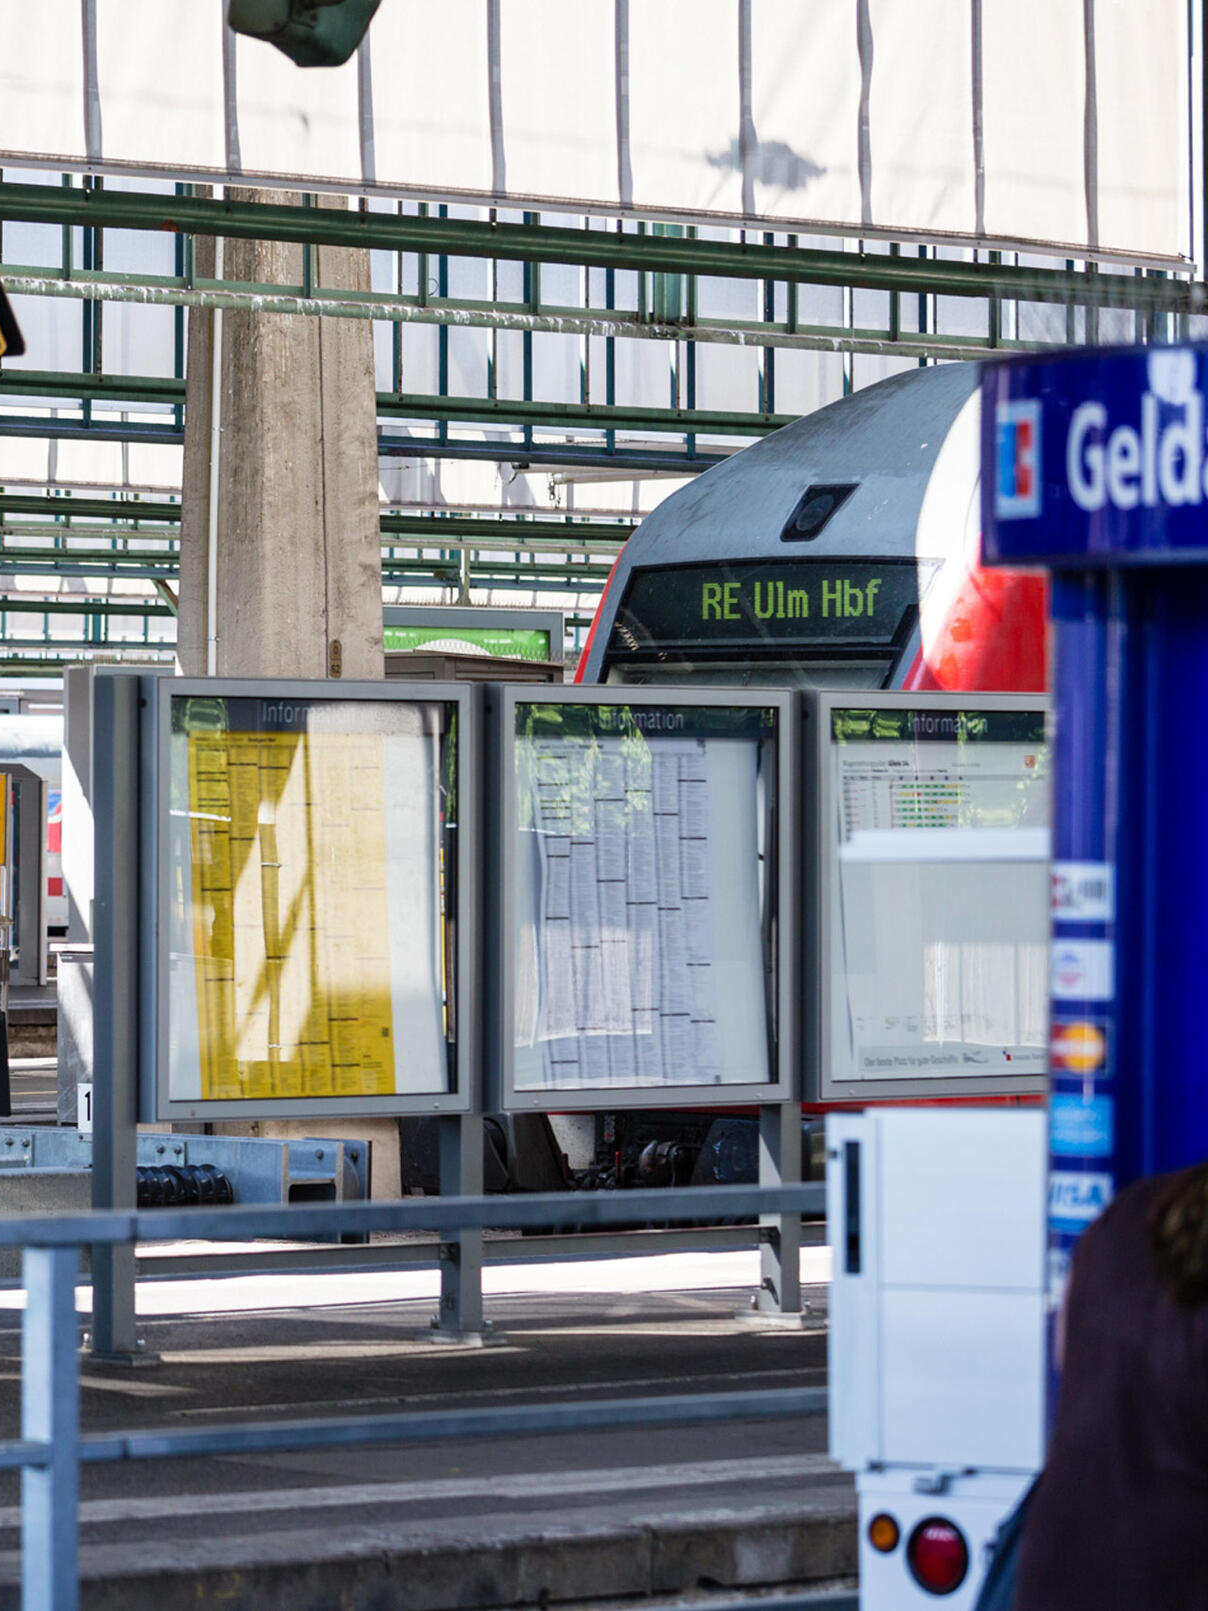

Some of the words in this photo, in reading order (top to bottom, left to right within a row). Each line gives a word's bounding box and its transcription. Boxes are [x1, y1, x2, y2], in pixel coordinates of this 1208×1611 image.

[1066, 391, 1208, 512] Geld
[702, 582, 741, 620] RE
[754, 581, 808, 619] Ulm
[822, 578, 883, 617] Hbf
